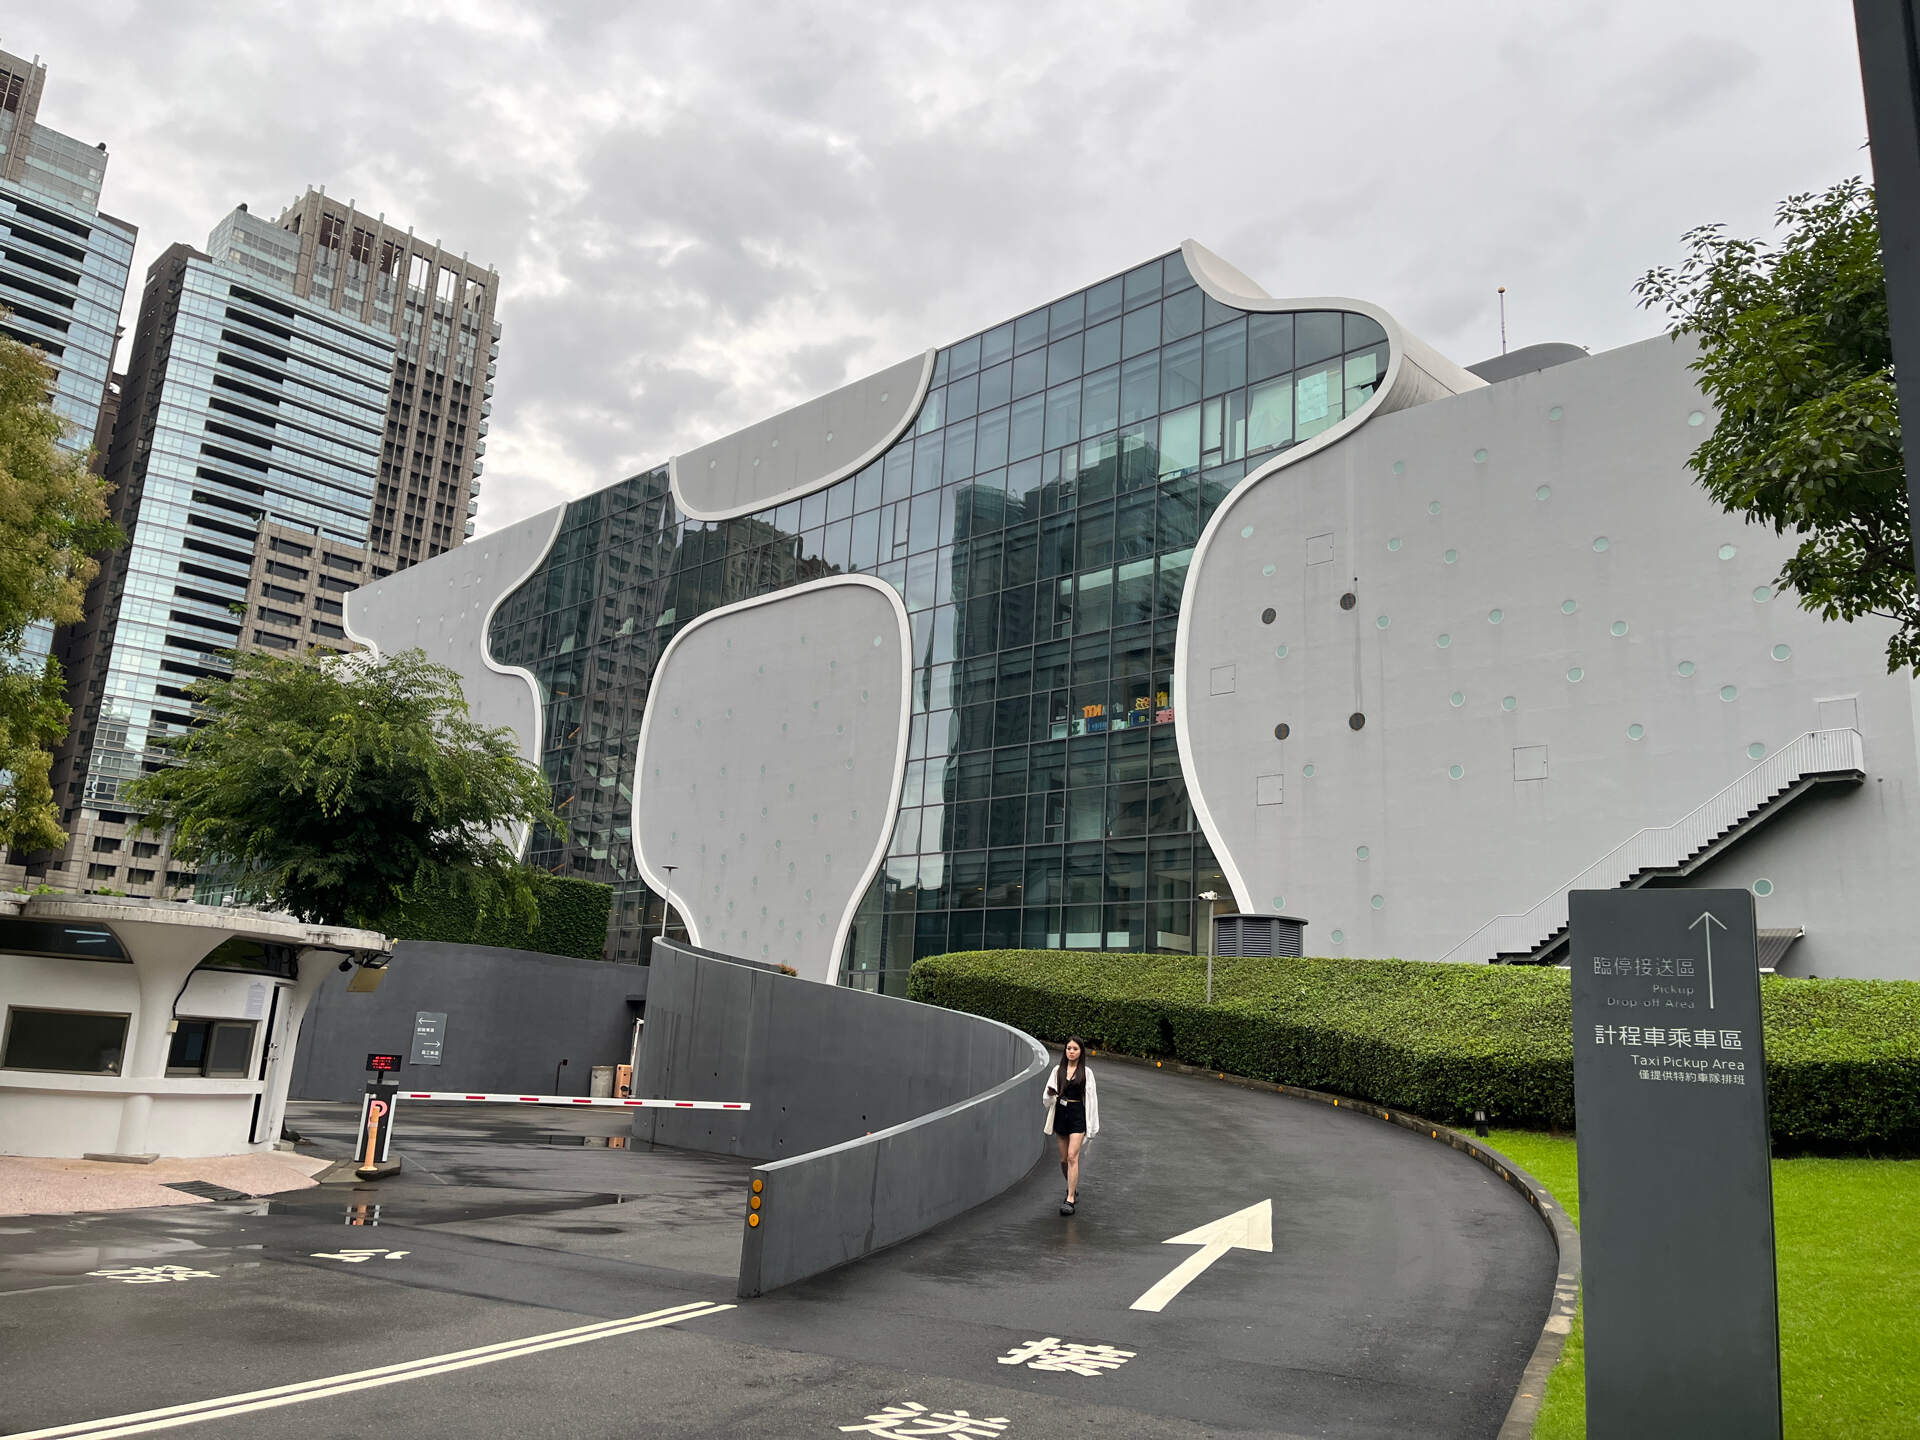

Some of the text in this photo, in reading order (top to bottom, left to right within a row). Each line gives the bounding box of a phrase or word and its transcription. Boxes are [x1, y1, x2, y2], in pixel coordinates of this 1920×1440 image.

[1594, 956, 1695, 977] 臨停接送區
[1653, 984, 1694, 996] Pickup
[1665, 999, 1695, 1009] Area
[1594, 1025, 1743, 1050] 計程車乘車區
[1631, 1054, 1745, 1071] Taxi Pickup Area
